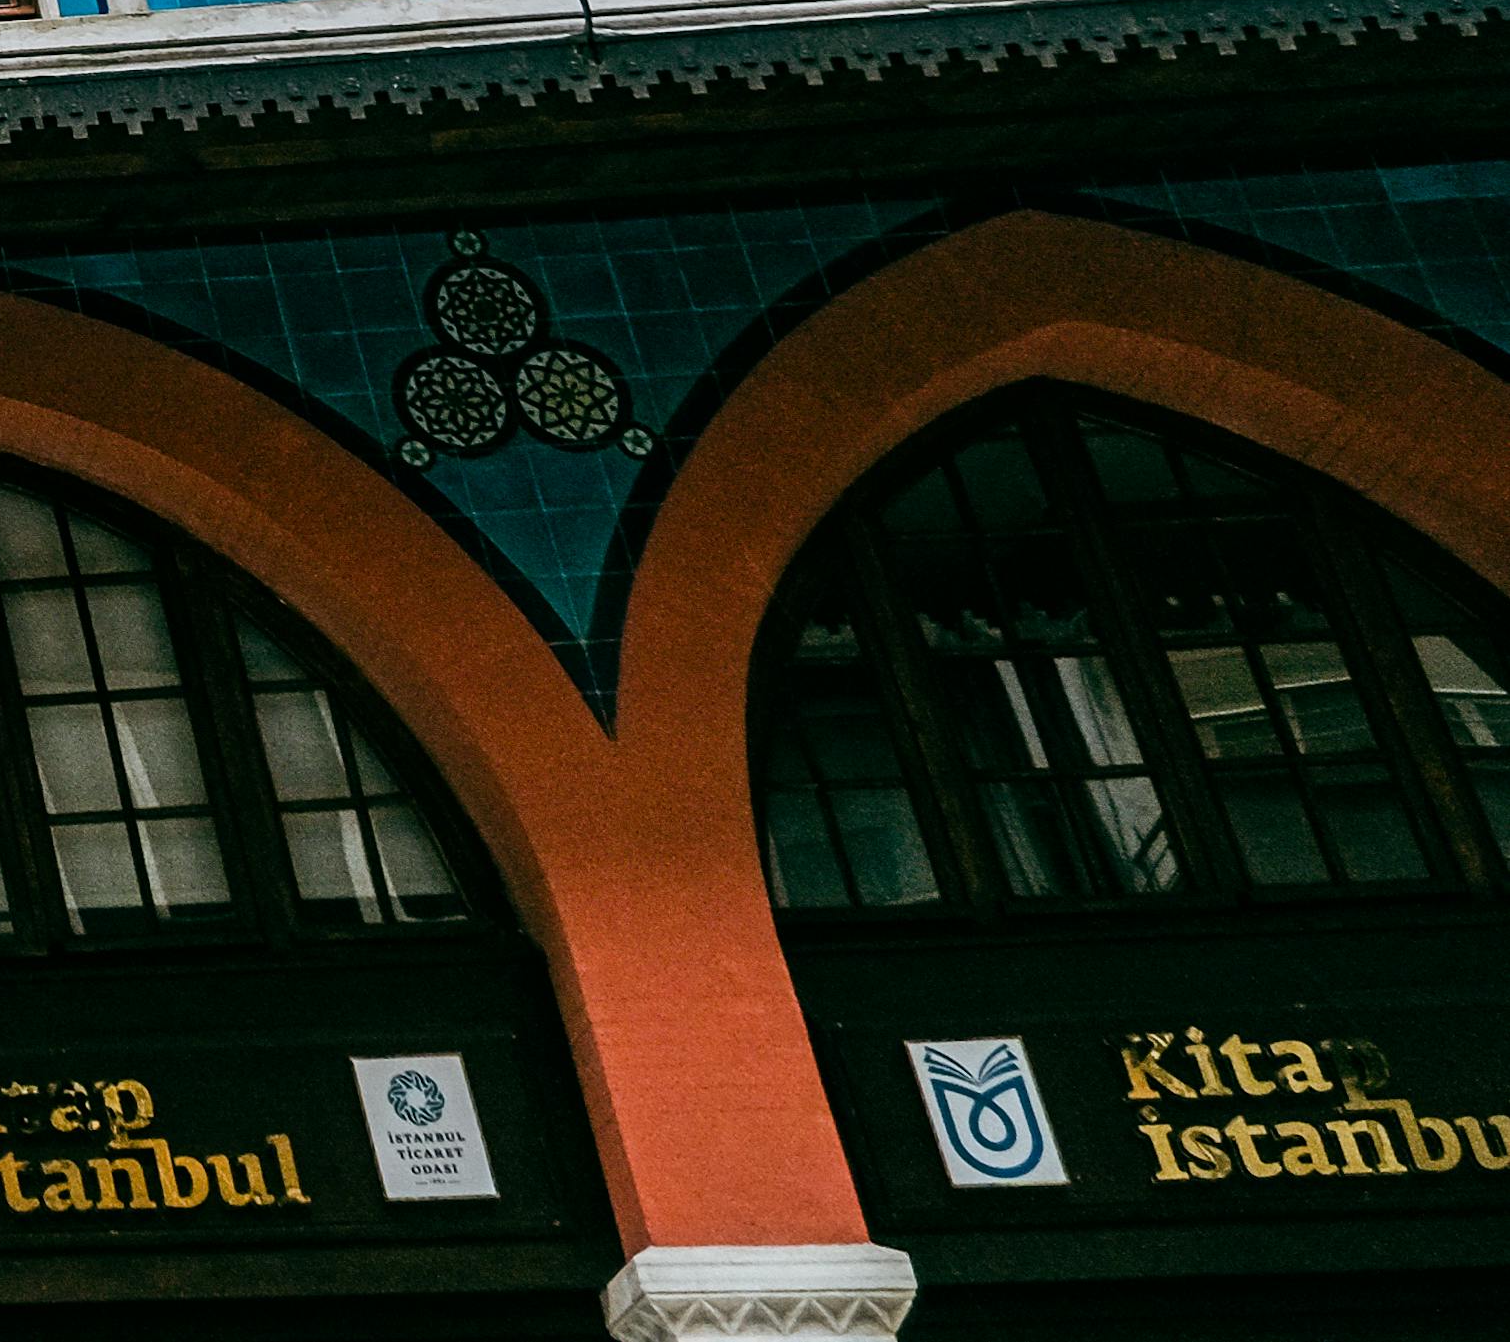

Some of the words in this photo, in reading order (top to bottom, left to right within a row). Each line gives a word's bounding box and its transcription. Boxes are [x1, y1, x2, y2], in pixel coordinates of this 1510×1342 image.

[1119, 1024, 1393, 1111] Kitap
[387, 1130, 466, 1145] İSTANBUL
[396, 1146, 464, 1161] TİCARET
[410, 1163, 459, 1176] ODASI
